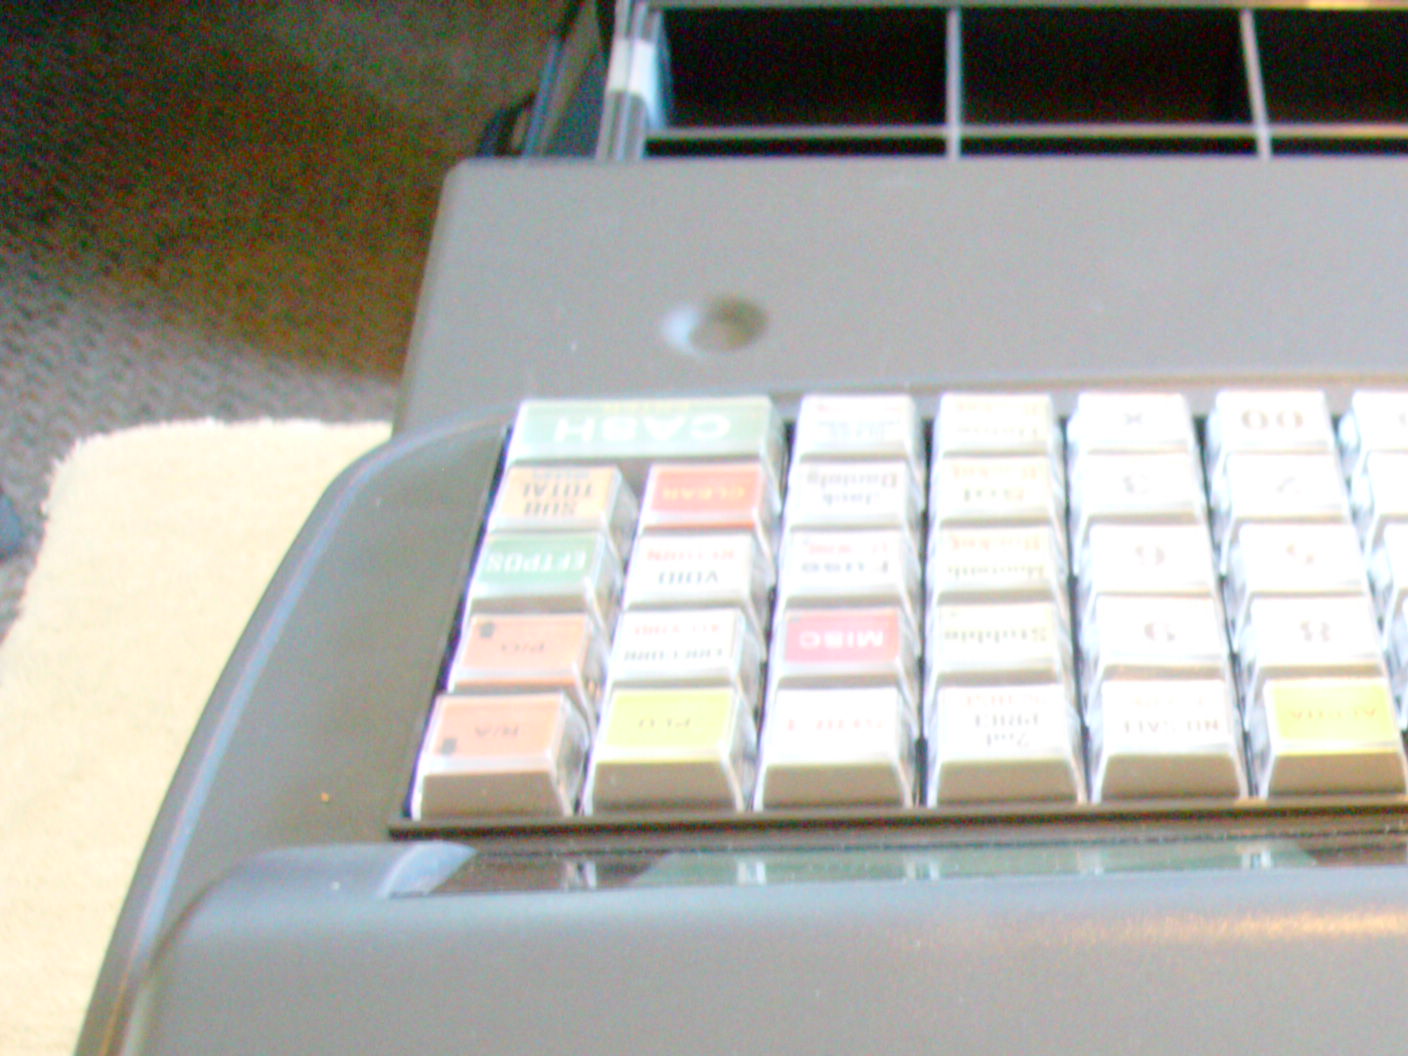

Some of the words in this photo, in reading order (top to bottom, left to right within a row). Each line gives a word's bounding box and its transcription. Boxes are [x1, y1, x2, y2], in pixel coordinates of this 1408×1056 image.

[552, 414, 731, 443] CASH
[522, 481, 594, 500] TOTAL
[660, 486, 745, 502] CLEAR
[524, 502, 575, 520] SUB
[484, 550, 588, 576] EFTPOS
[657, 569, 719, 585] VOID
[800, 629, 884, 647] MISC
